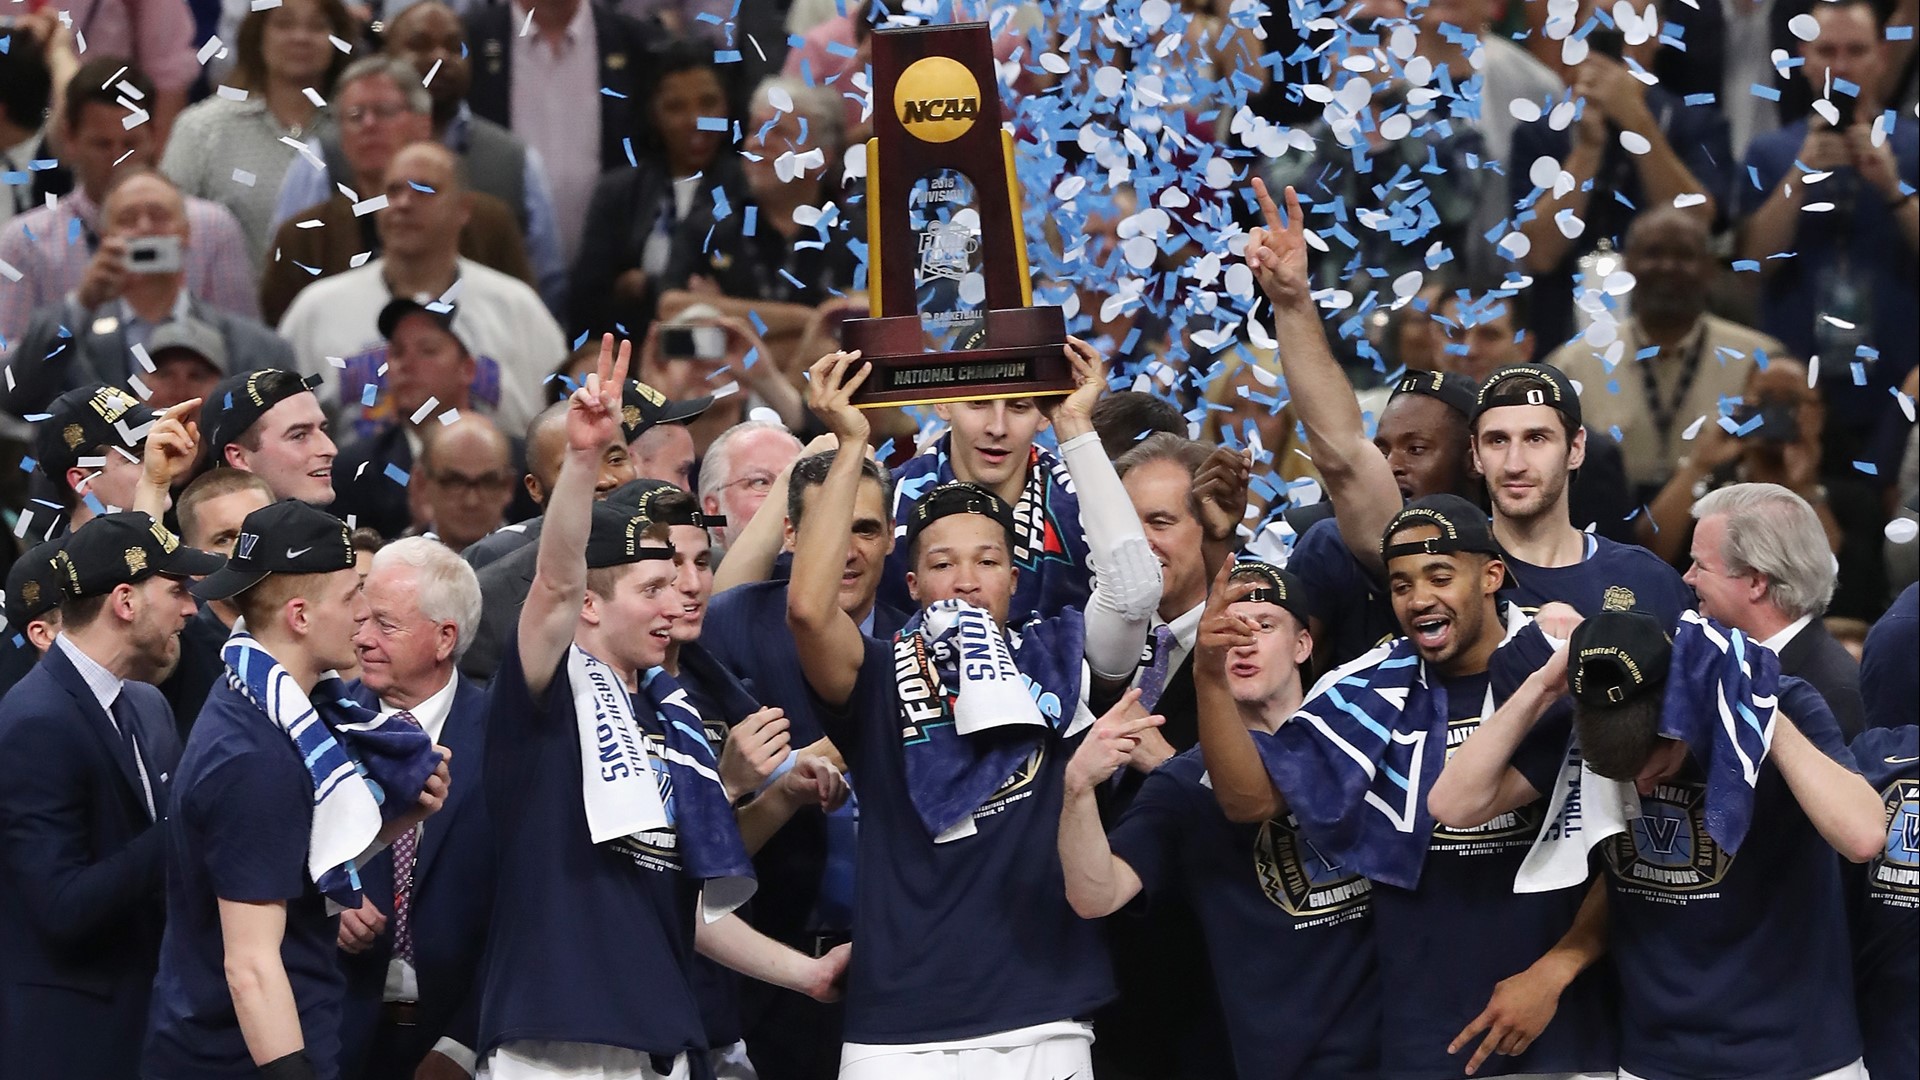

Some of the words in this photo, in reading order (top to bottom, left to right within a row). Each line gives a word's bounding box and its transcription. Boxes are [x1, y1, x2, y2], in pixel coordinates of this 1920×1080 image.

[902, 96, 977, 124] NCAA
[931, 178, 955, 190] 2018
[933, 309, 984, 320] BASKETBALL
[894, 366, 955, 385] NATIONAL
[958, 362, 1027, 380] CHAMPION
[238, 532, 260, 560] V
[894, 636, 942, 723] FOUR
[588, 671, 646, 777] BASKETBALL
[1445, 812, 1517, 833] PIONS
[1641, 815, 1681, 854] V
[1632, 863, 1700, 884] CHAMPIONS
